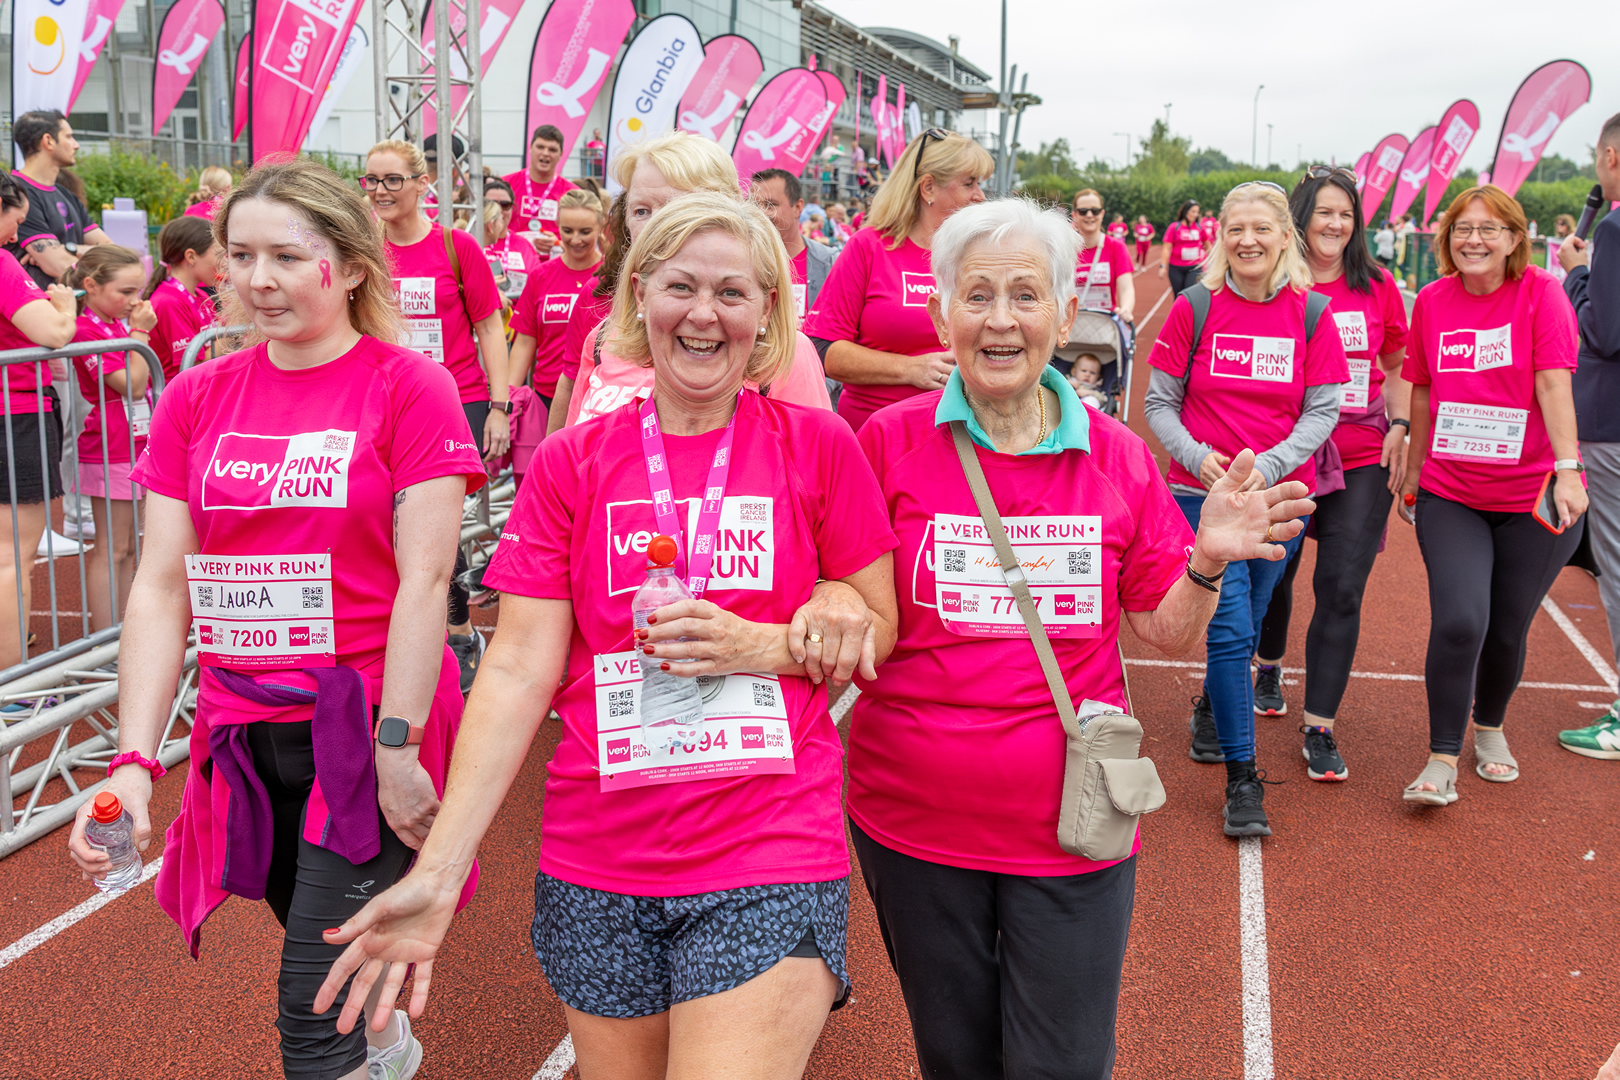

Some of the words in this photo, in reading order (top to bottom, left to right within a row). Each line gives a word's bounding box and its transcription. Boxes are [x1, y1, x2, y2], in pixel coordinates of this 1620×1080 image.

[283, 14, 318, 73] very
[552, 0, 595, 84] breastcancerirela
[636, 37, 686, 114] Glanbia
[404, 291, 432, 300] PINK
[404, 302, 428, 310] RUN
[546, 304, 570, 314] very
[1344, 336, 1362, 347] UN
[1480, 339, 1508, 355] PINK
[1216, 348, 1252, 364] very
[1442, 344, 1474, 358] very
[1478, 350, 1504, 366] RUN
[1256, 353, 1289, 365] PINK
[1256, 365, 1286, 376] RUN
[1448, 406, 1472, 415] VERY
[1474, 408, 1496, 418] PINK
[1498, 411, 1519, 420] RUN
[1464, 442, 1491, 452] 7235
[214, 459, 280, 486] very
[284, 456, 344, 477] PINK
[278, 477, 333, 498] RUN
[1047, 524, 1084, 538] RUN
[717, 529, 768, 552] INK
[200, 562, 231, 575] VERY
[235, 562, 274, 576] PINK
[280, 561, 316, 574] RUN
[219, 586, 274, 609] LAURA
[943, 598, 960, 606] very
[990, 596, 1042, 614] 777
[1056, 601, 1074, 609] very
[200, 631, 213, 640] very
[230, 629, 278, 648] 7200
[290, 632, 309, 640] very
[614, 659, 640, 676] VE
[742, 733, 763, 742] very
[608, 746, 630, 756] very
[632, 750, 650, 758] RUN
